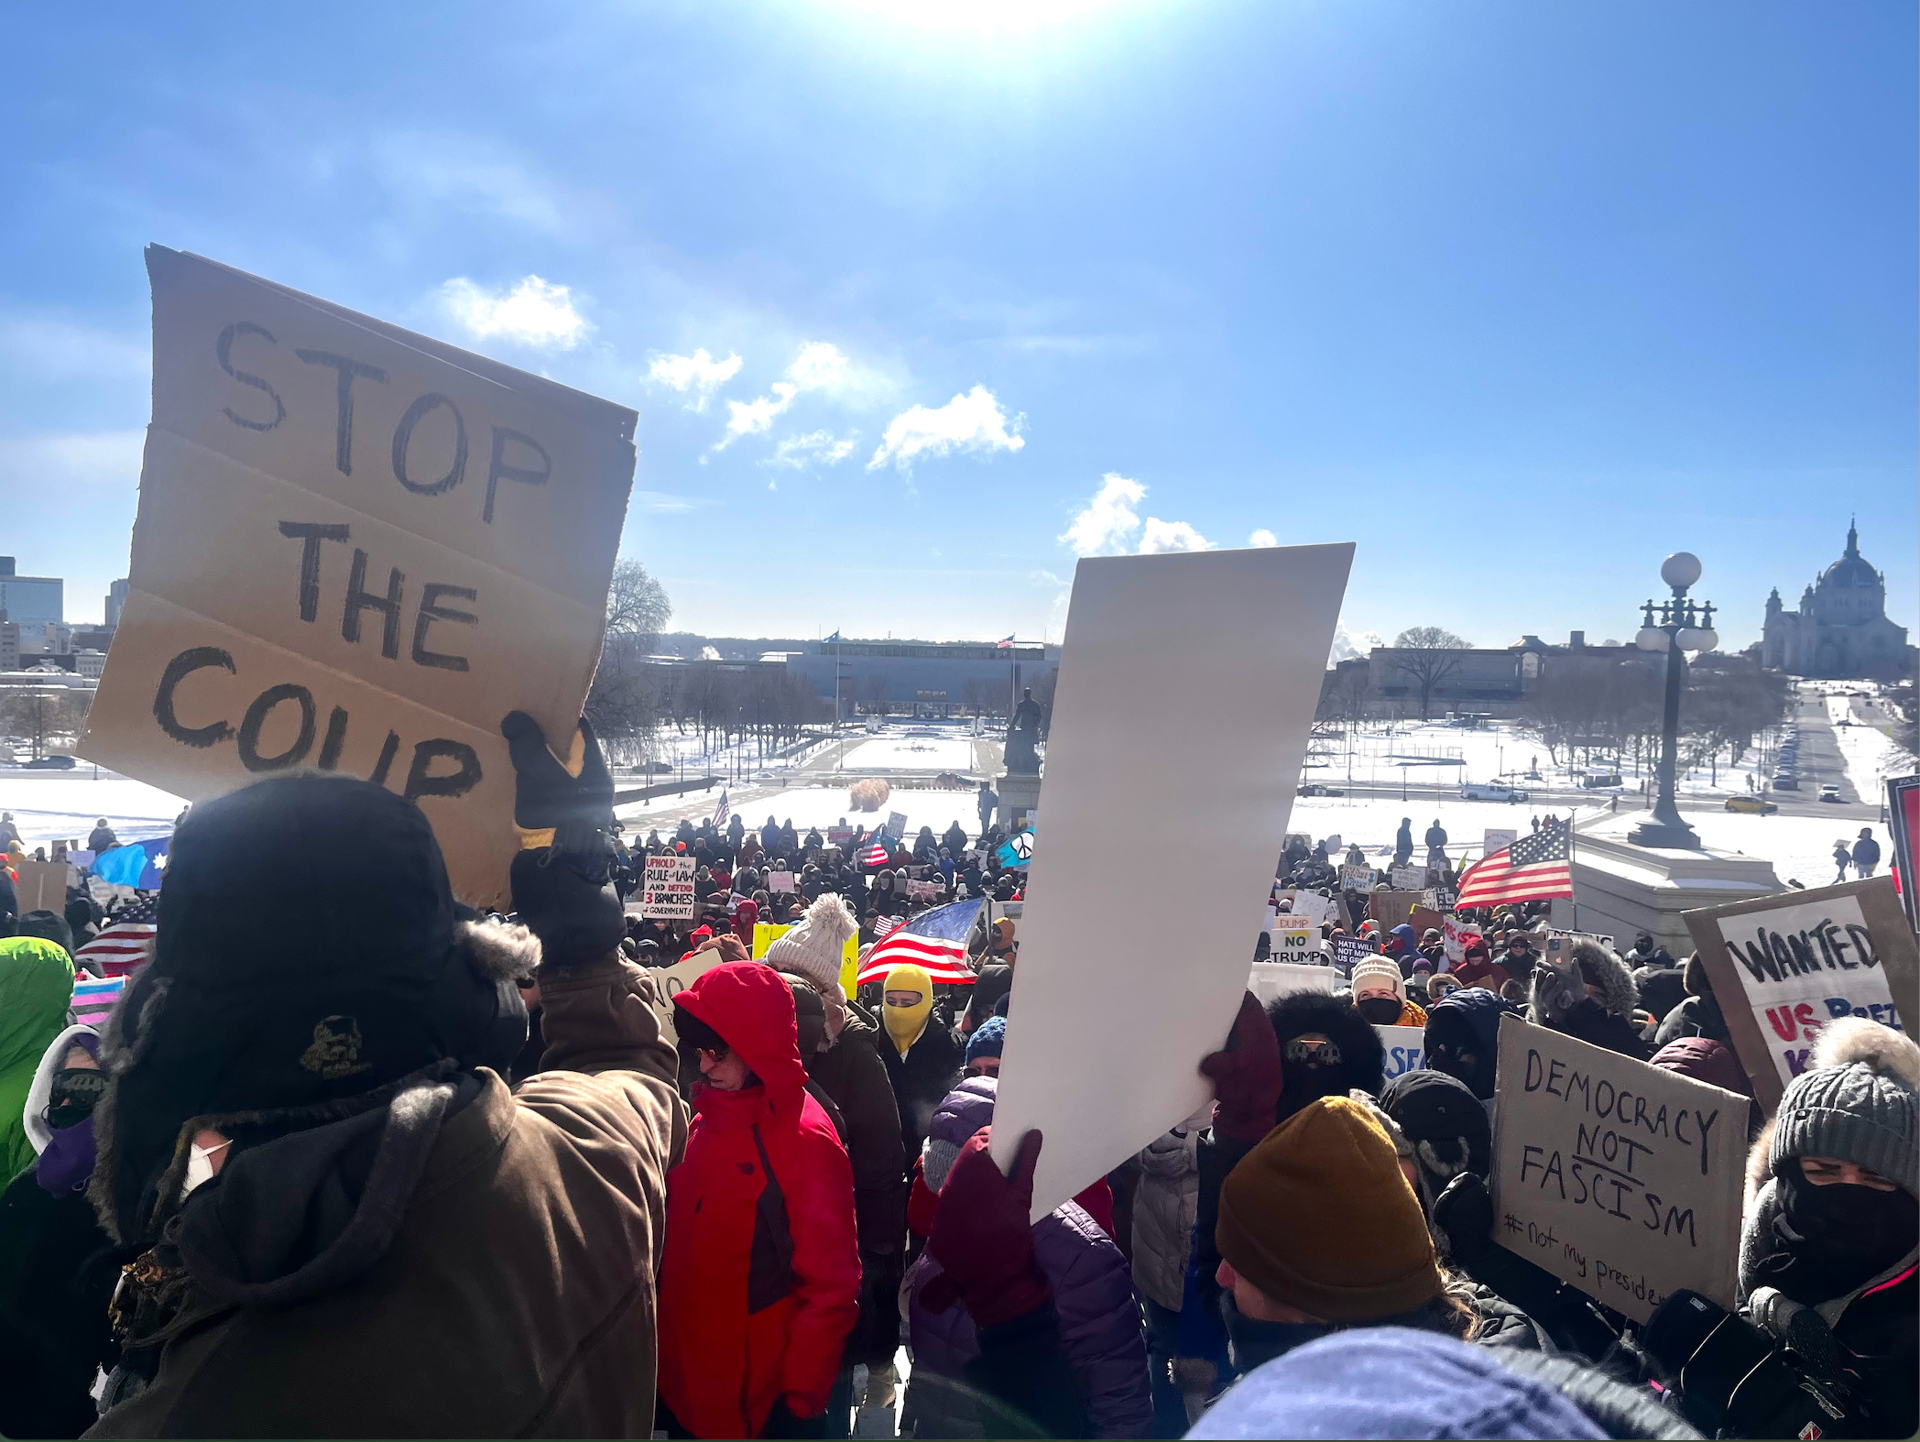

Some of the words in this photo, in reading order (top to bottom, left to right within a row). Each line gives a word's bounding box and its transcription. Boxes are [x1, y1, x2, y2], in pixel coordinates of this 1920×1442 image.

[216, 321, 551, 524] STOP
[279, 520, 478, 672] THE
[154, 646, 482, 800] COUP
[646, 858, 676, 868] UPHOLD
[679, 861, 691, 869] the
[647, 869, 668, 881] RULE
[676, 870, 695, 882] LAW
[668, 884, 693, 892] DEFEND
[645, 892, 653, 904] 3
[654, 893, 693, 905] BRANCHES
[1280, 919, 1308, 928] DUMP
[1285, 936, 1306, 947] NO
[1338, 940, 1356, 949] HATE
[1357, 942, 1374, 951] WILL
[1338, 948, 1353, 956] NOT
[1354, 949, 1370, 958] MAK
[1726, 918, 1880, 983] WANTED
[1271, 952, 1320, 963] TRUMP
[1337, 955, 1348, 963] US
[1765, 1003, 1823, 1042] US
[1524, 1049, 1718, 1175] DEMOCRACY
[1577, 1123, 1653, 1173] NOT
[1521, 1146, 1696, 1247] FASCISM
[1564, 1244, 1586, 1277] my
[1596, 1260, 1666, 1306] preside
